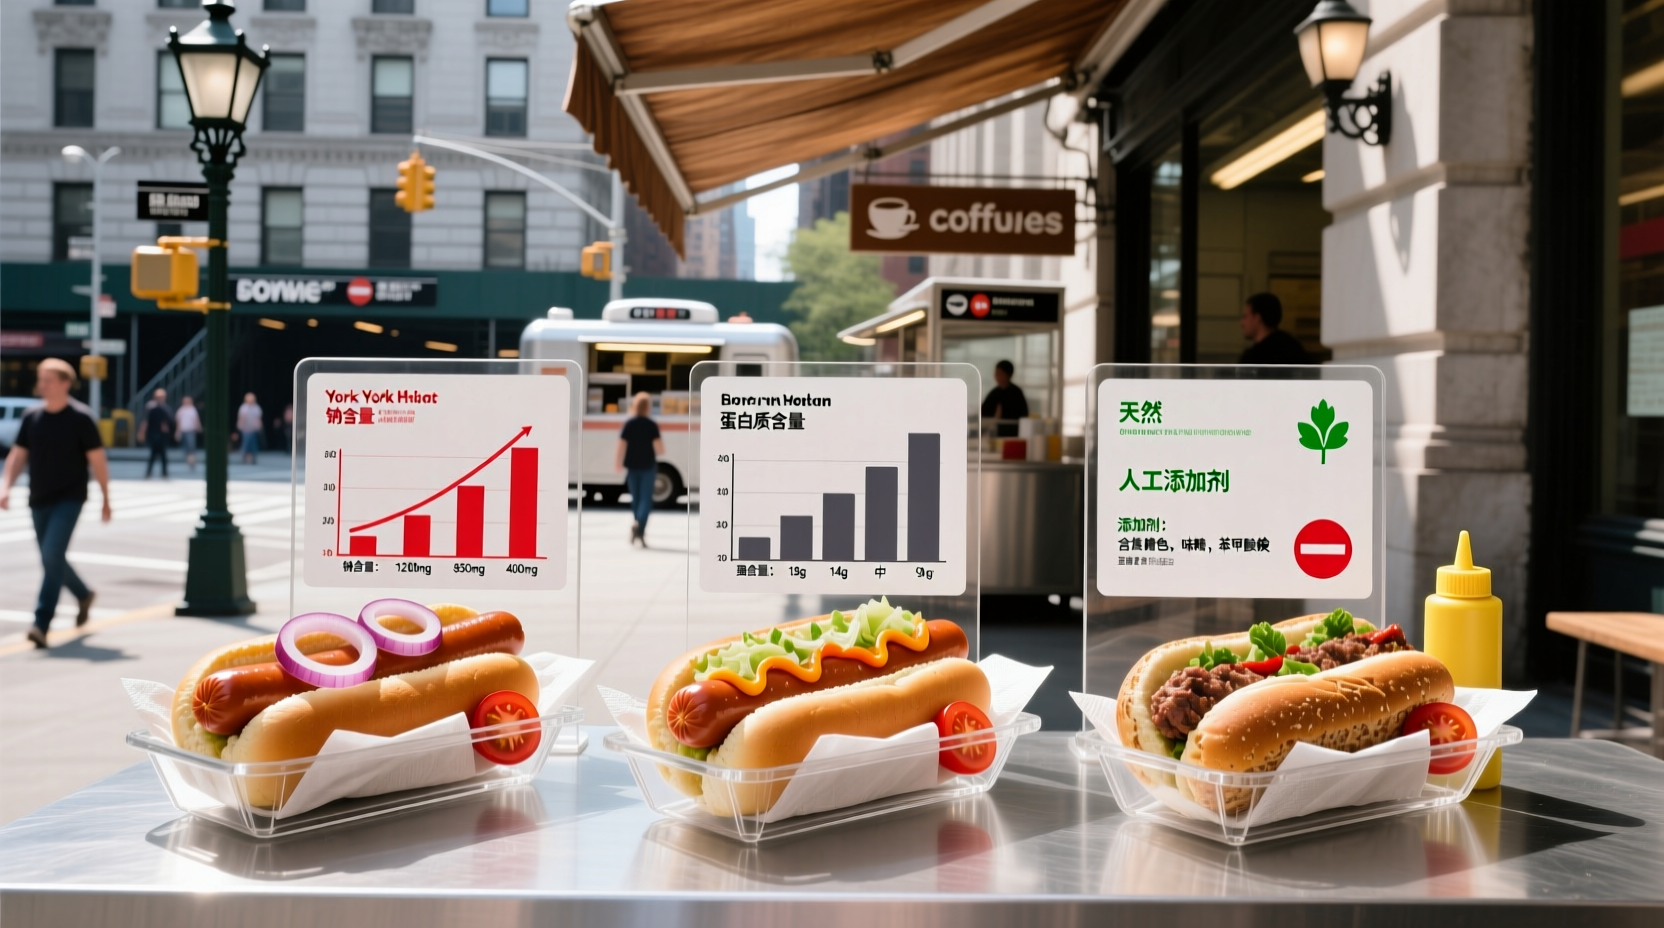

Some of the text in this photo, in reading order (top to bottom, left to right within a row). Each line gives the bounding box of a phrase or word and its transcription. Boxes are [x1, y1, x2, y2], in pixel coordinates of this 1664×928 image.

[325, 389, 359, 404] York
[362, 389, 394, 404] York
[720, 411, 806, 430] 蛋白质含量
[1119, 400, 1163, 424] 天然
[1119, 468, 1230, 493] 人工添加剂
[830, 566, 848, 580] 14g
[874, 564, 887, 579] 中
